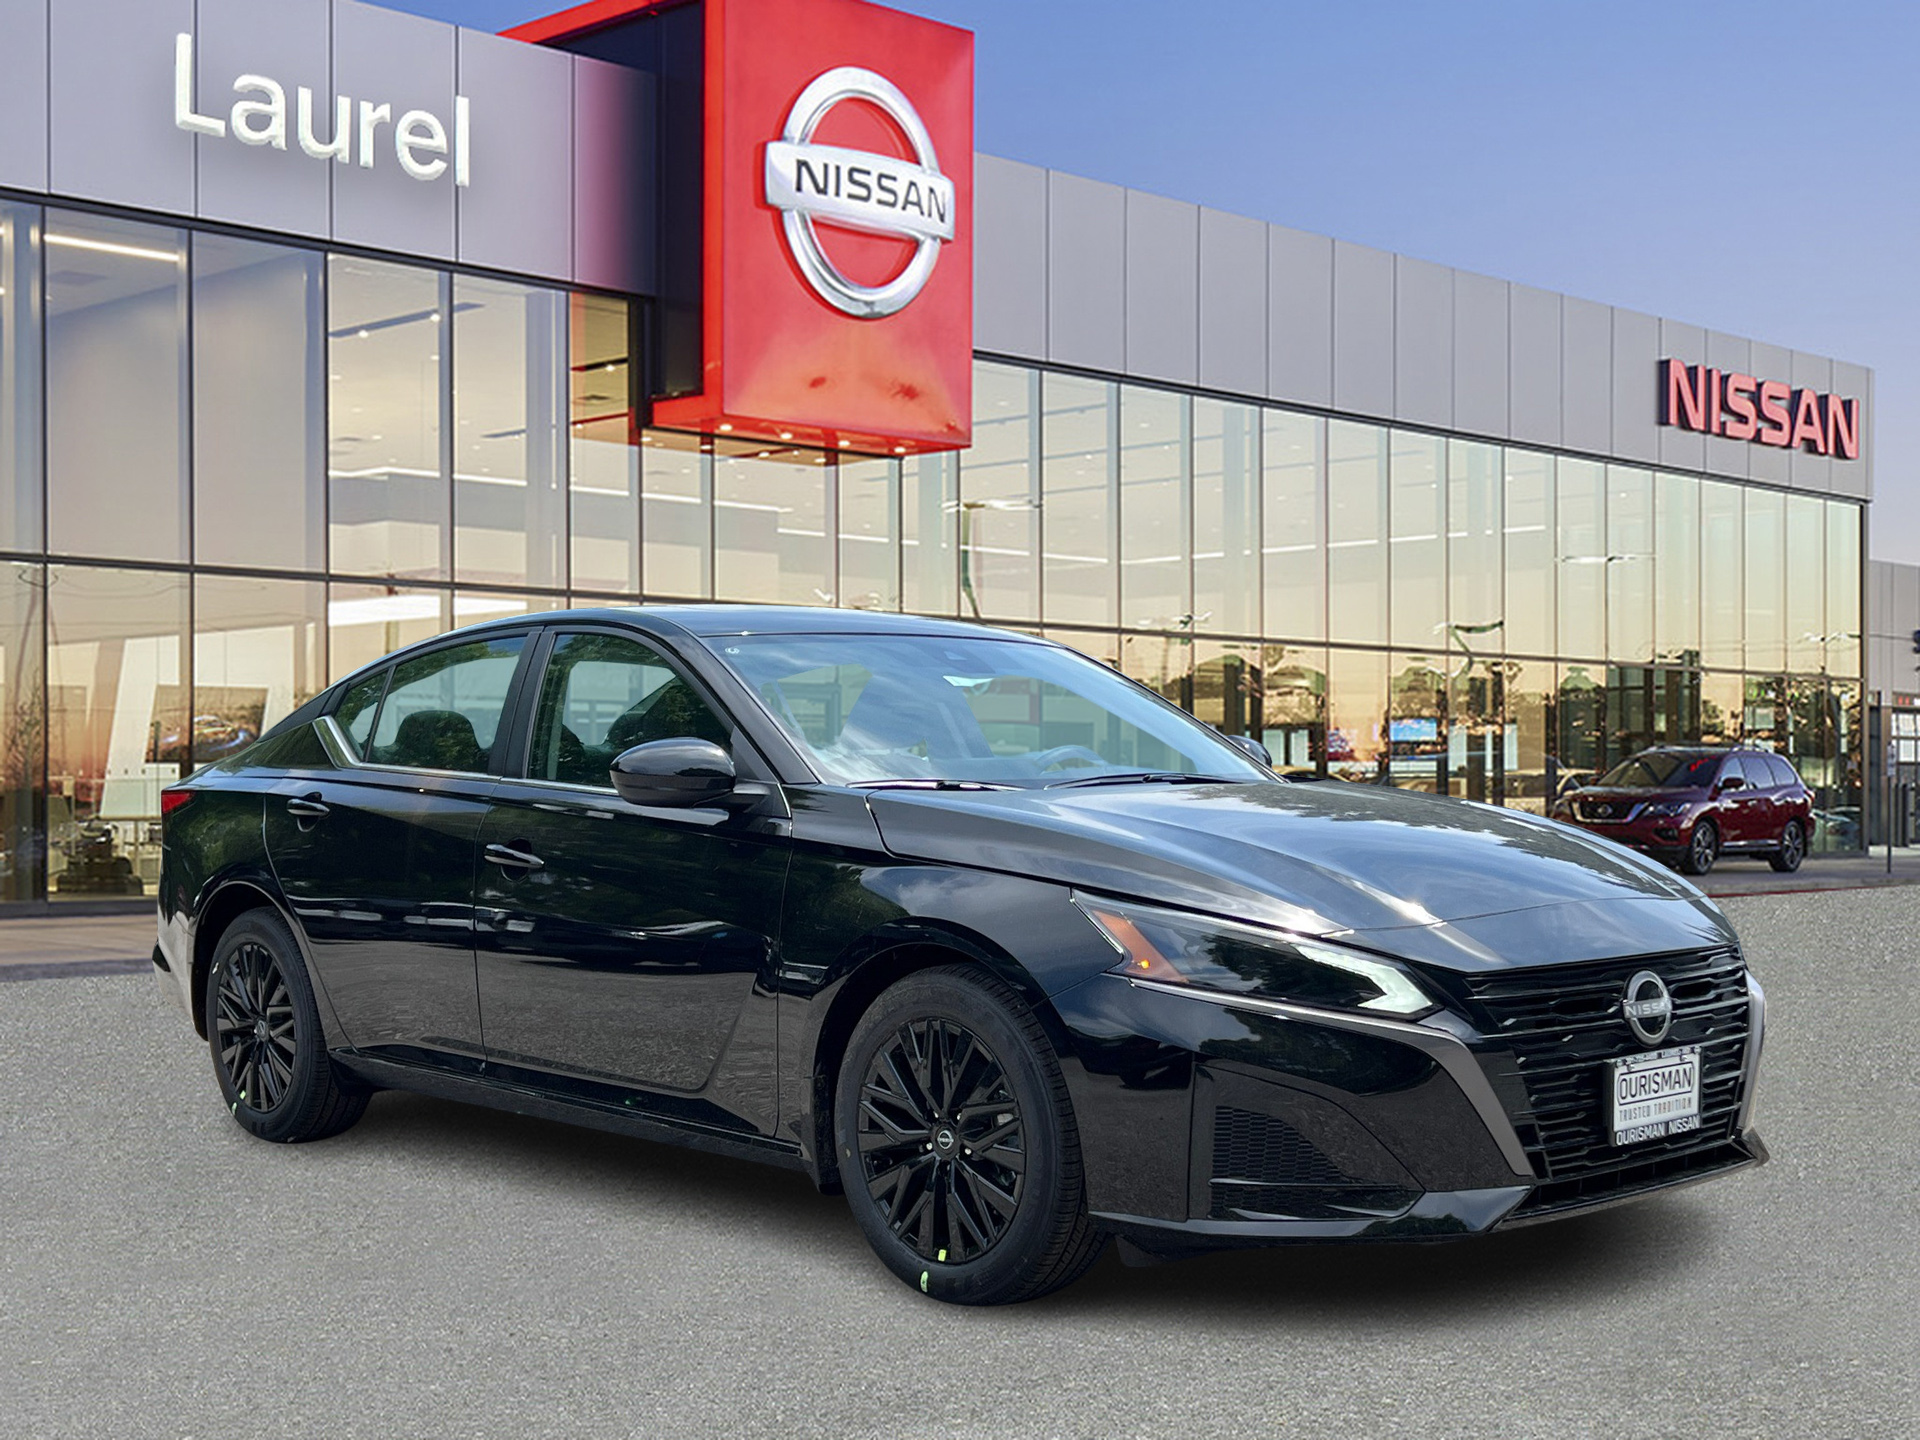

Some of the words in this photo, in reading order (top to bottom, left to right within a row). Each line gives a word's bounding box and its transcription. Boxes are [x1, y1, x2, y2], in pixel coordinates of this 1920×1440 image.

[175, 33, 470, 187] Laurel
[795, 158, 946, 223] NISSAN
[1658, 358, 1860, 460] NISSAN
[1619, 1067, 1692, 1100] OURISMAN
[1616, 1122, 1666, 1146] OURISMAN
[1668, 1114, 1700, 1135] NISSAN
